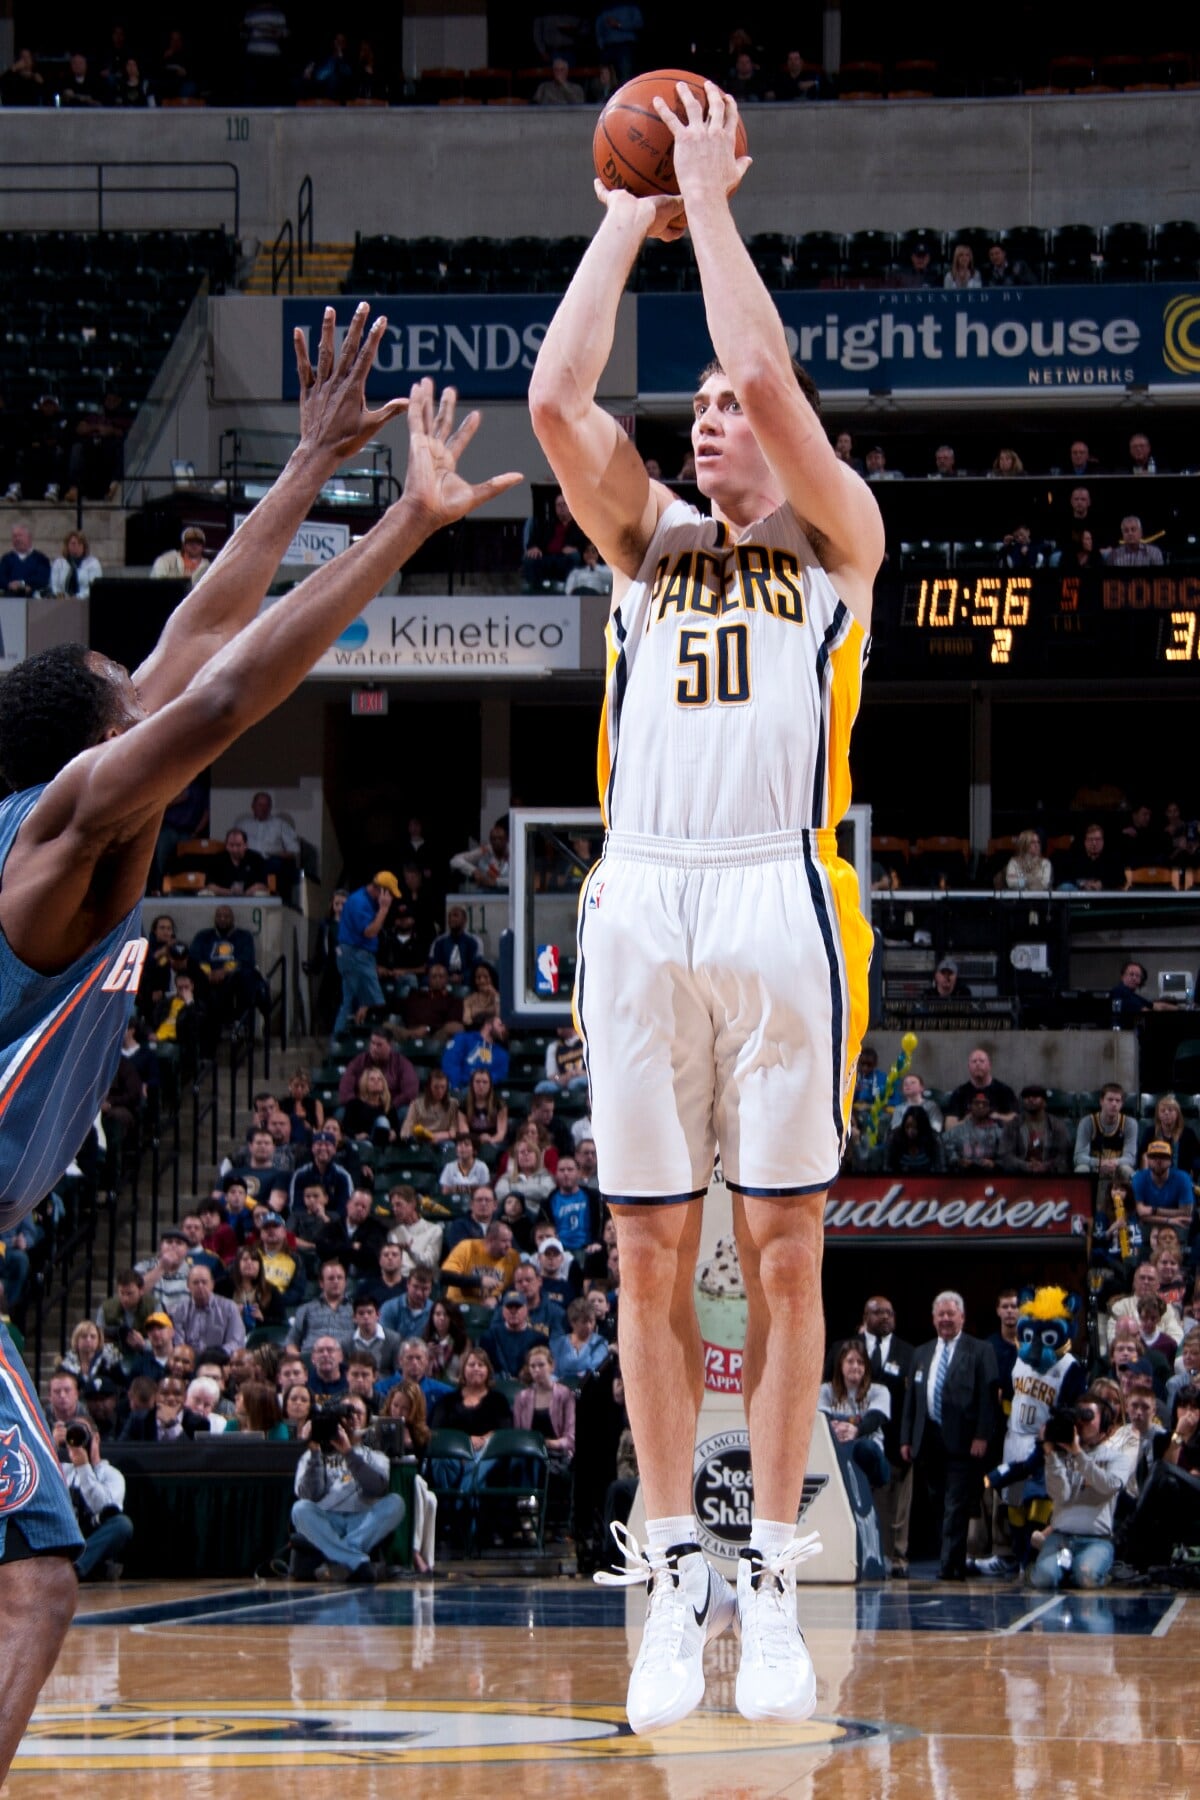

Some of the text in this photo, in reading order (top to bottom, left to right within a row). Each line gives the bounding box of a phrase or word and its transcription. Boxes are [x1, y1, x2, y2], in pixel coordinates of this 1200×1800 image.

[225, 117, 249, 141] 110
[1003, 291, 1023, 302] BY
[955, 312, 1141, 358] house
[1028, 367, 1135, 384] NETWORKS
[917, 577, 1032, 626] 10:56
[391, 616, 564, 648] Kinetico
[991, 627, 1012, 663] 2
[1166, 611, 1200, 661] 3
[335, 649, 402, 665] water
[675, 623, 752, 709] 50
[357, 691, 384, 713] EXIT
[252, 908, 262, 936] 9
[824, 1183, 1072, 1230] udweiser
[704, 1371, 743, 1392] APPY
[699, 1433, 750, 1458] FAMOU
[705, 1459, 753, 1489] Stea
[703, 1497, 754, 1526] Sha
